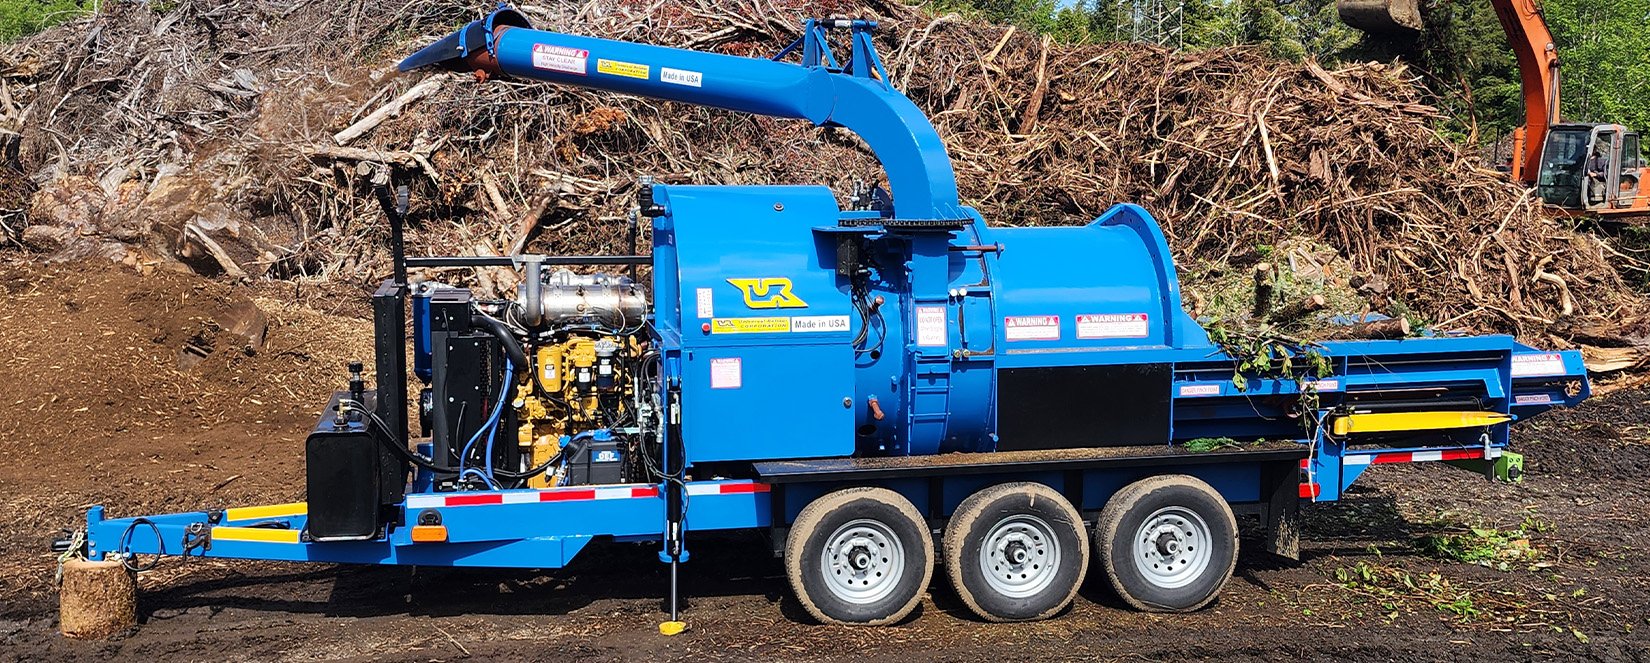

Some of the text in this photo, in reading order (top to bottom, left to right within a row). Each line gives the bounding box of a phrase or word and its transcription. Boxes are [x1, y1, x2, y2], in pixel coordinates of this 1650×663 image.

[542, 45, 577, 57] WARNING
[663, 71, 699, 83] Made in USA
[794, 319, 846, 328] Made in USA
[1016, 316, 1047, 326] WARNING
[1090, 314, 1132, 323] WARNING
